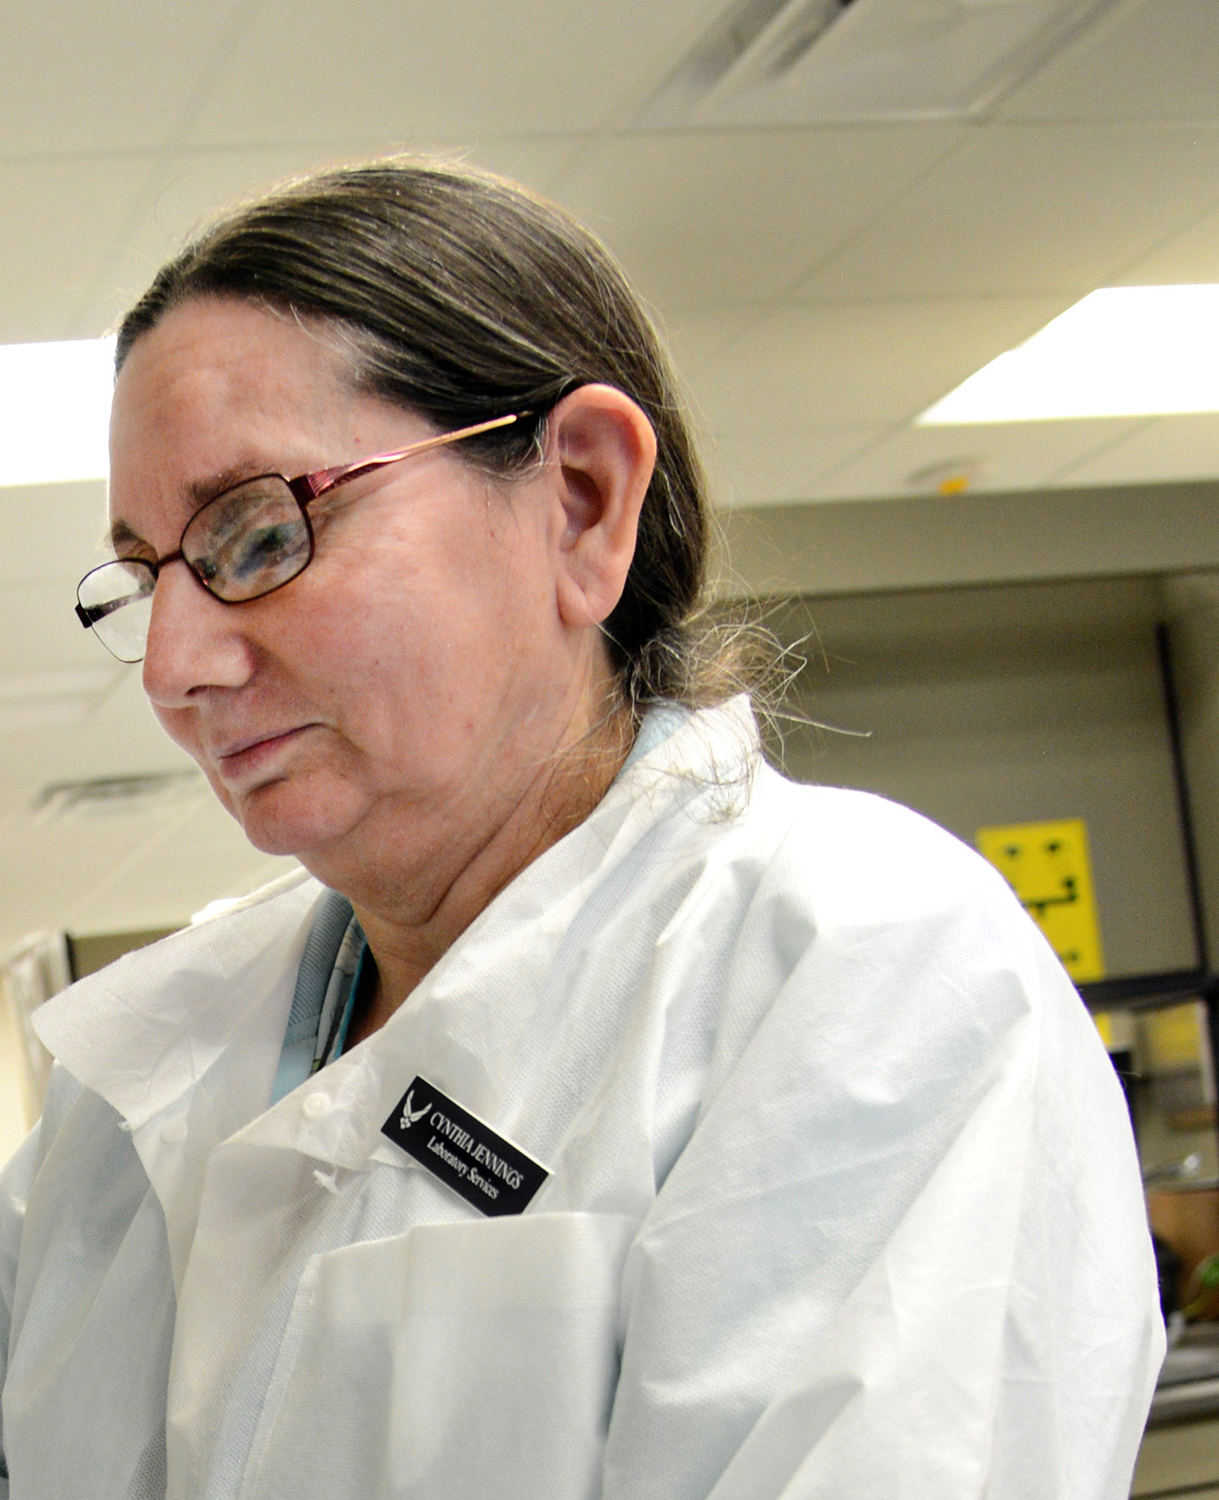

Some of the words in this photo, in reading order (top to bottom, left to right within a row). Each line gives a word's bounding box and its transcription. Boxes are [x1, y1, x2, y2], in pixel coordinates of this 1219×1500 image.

[426, 1135, 469, 1178] Laboratory
[467, 1167, 500, 1200] Services
[429, 1111, 474, 1154] CYNTHIA
[471, 1140, 524, 1190] JENNINGS
